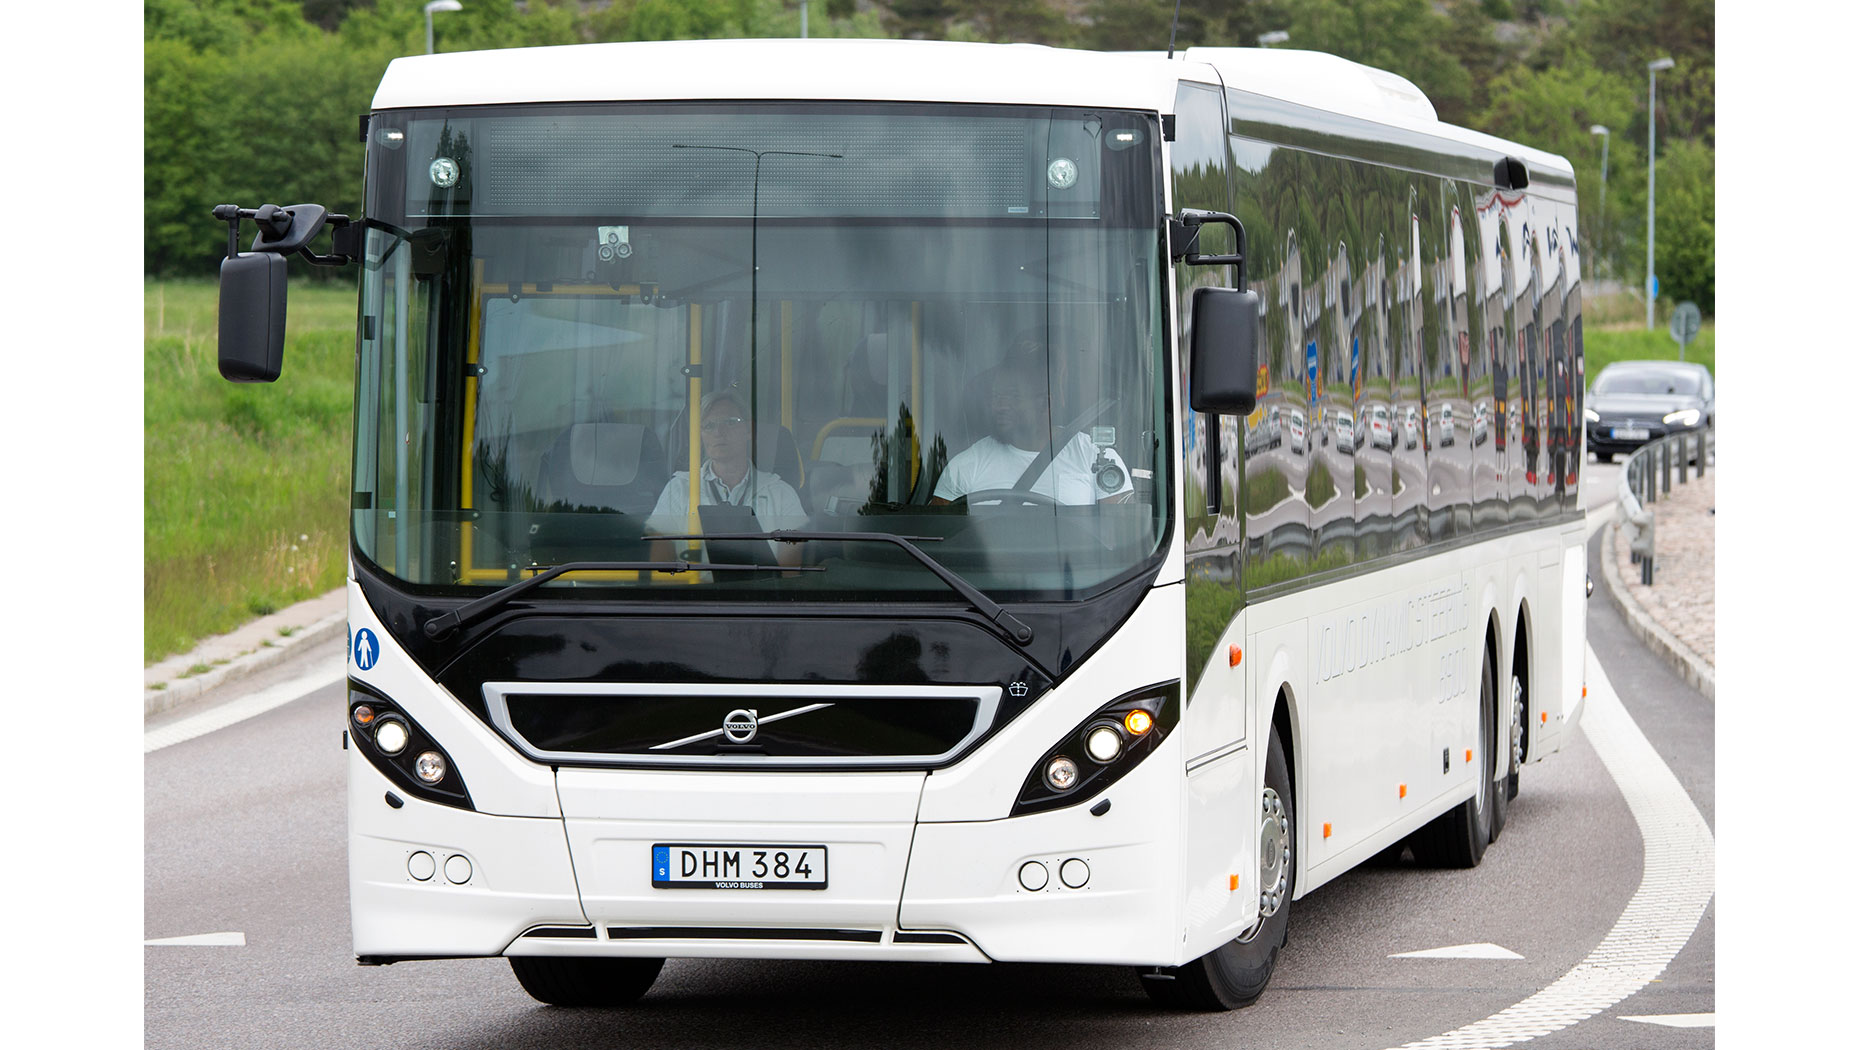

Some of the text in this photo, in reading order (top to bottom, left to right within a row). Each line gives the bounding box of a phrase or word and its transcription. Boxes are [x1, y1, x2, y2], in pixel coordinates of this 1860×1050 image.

[659, 868, 665, 876] S
[681, 850, 812, 879] DHM 384
